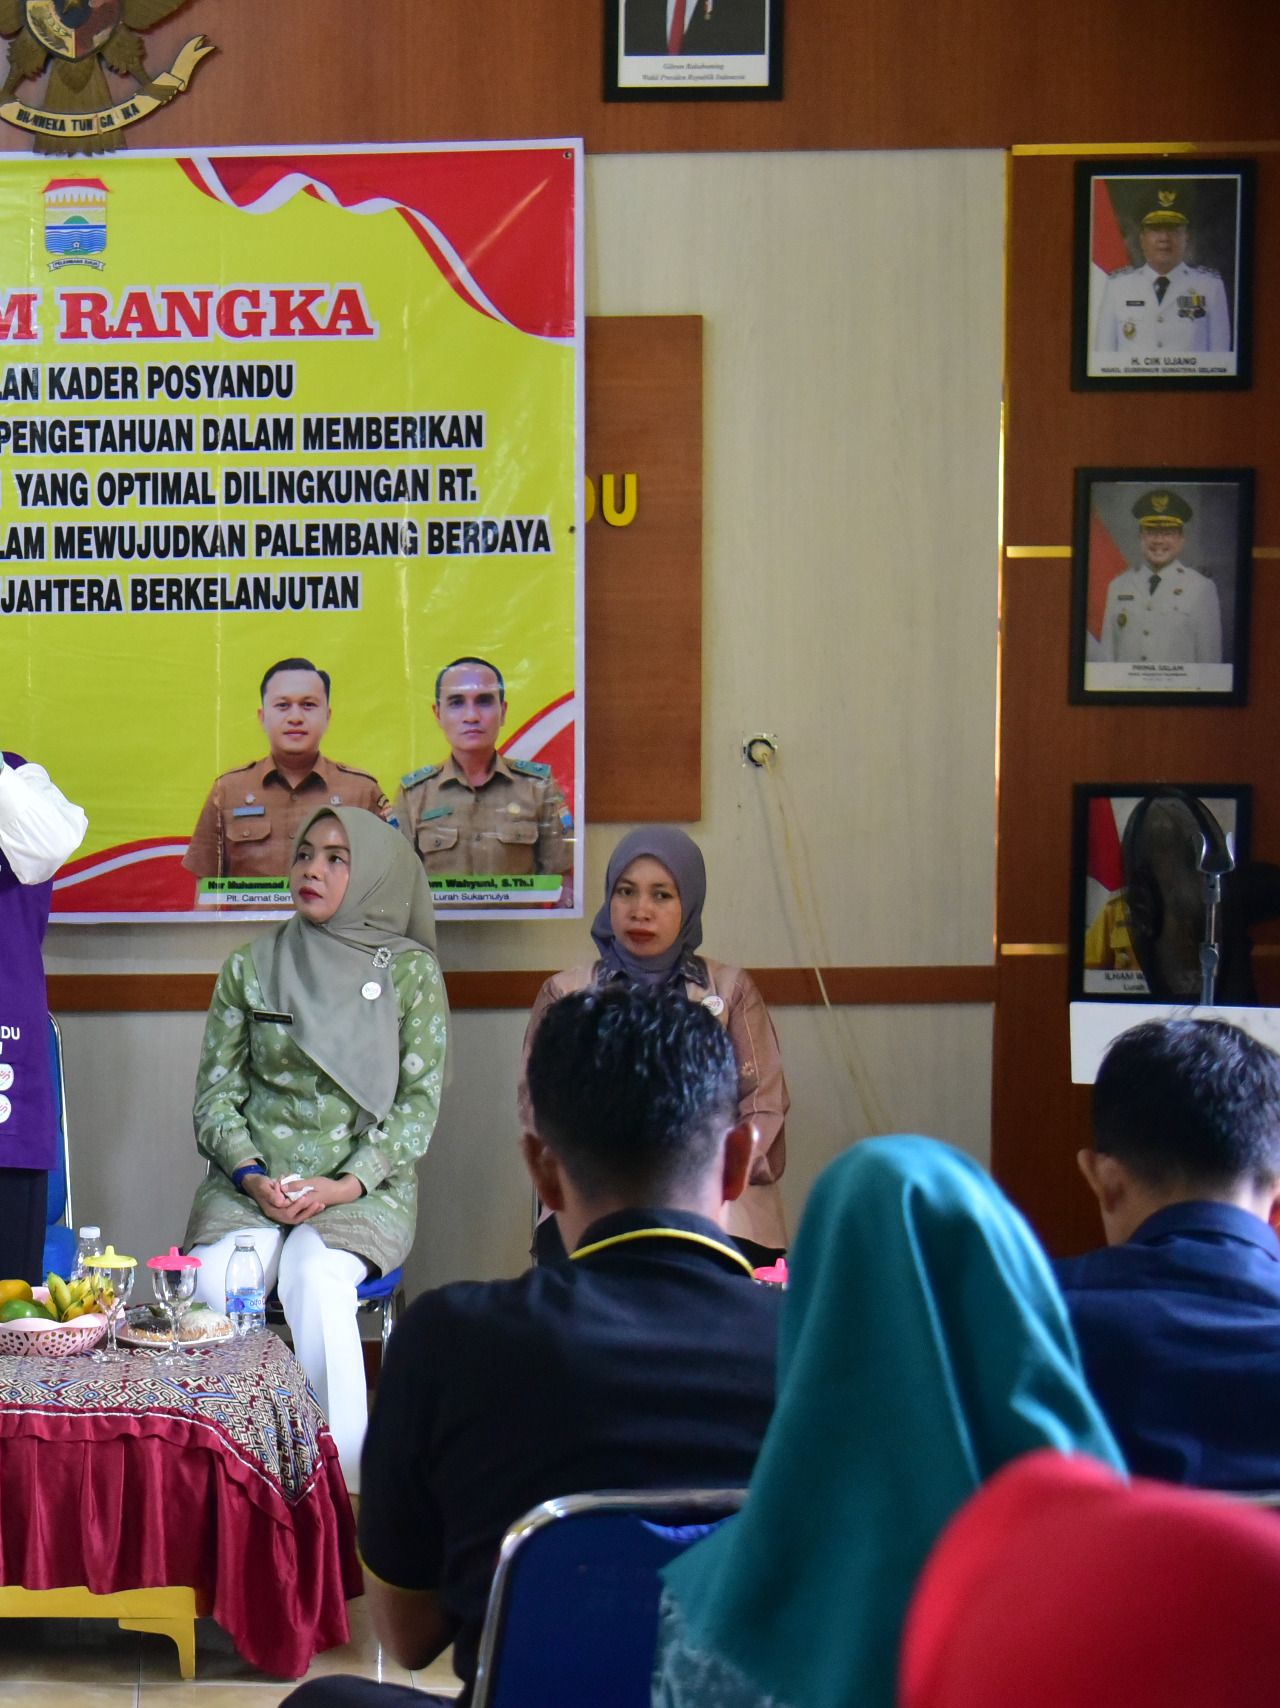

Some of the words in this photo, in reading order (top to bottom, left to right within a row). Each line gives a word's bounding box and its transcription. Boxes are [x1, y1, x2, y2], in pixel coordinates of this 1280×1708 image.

[121, 103, 140, 120] IKA
[60, 289, 373, 339] RANGKA
[49, 367, 138, 400] KADER
[147, 364, 293, 399] POSYANDU
[203, 417, 294, 451] DALAM
[304, 414, 483, 450] MEMBERIKAN
[17, 472, 88, 507] YANG
[98, 471, 216, 506] OPTIMAL
[224, 468, 429, 504] DILINGKUNGAN
[439, 468, 477, 502] RT.
[54, 523, 246, 559] MEWUJUDKAN
[255, 521, 418, 557] PALEMBANG
[427, 519, 551, 555] BERDAYA
[131, 576, 359, 612] BERKELANJUTAN
[242, 894, 271, 902] Camat
[434, 892, 459, 901] Lurah
[461, 892, 510, 902] Sukamulya
